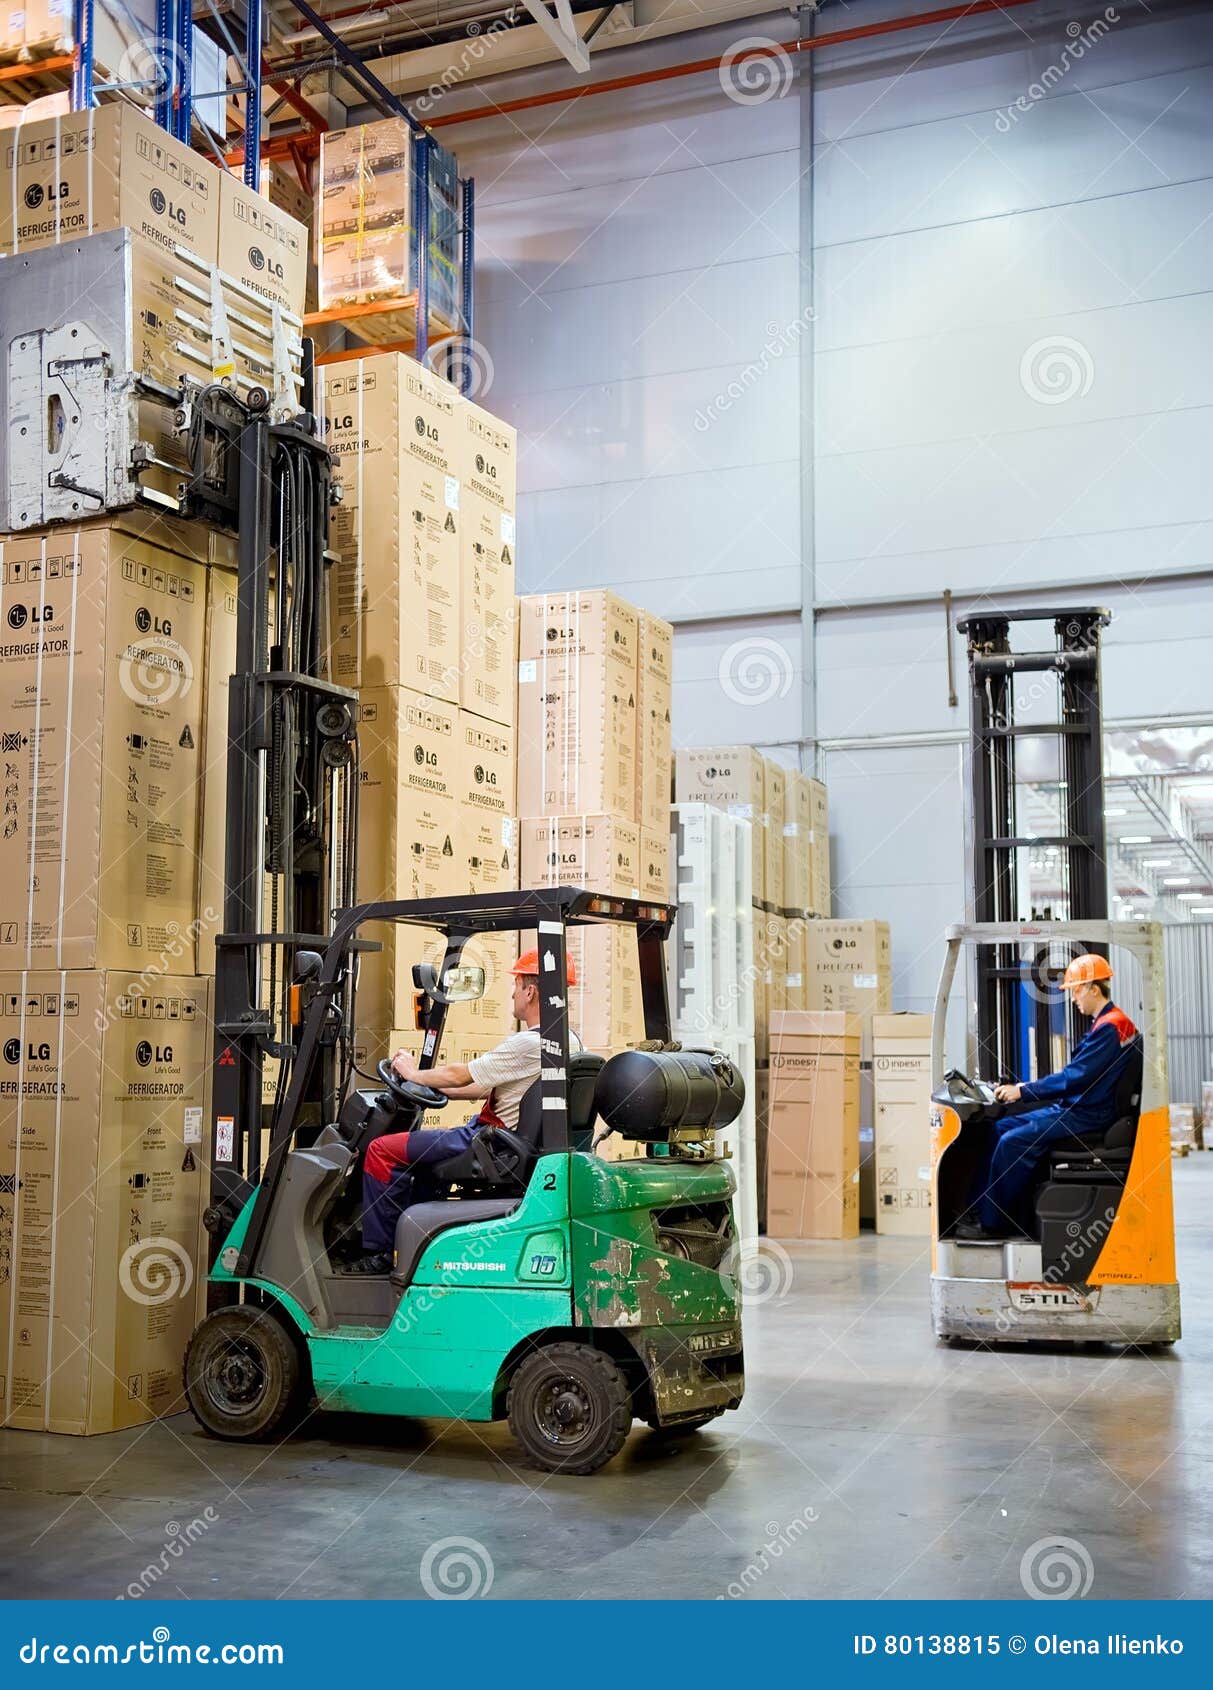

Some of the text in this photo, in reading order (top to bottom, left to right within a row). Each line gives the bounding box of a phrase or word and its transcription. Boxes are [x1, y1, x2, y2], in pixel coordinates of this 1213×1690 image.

[48, 182, 69, 201] LG
[169, 203, 186, 226] LG
[268, 259, 283, 279] LG
[334, 416, 353, 429] LG
[427, 425, 438, 441] LG
[486, 463, 496, 478] LG
[32, 605, 53, 622] LG
[154, 616, 171, 636] LG
[128, 645, 183, 672] REFRIGERATOR
[426, 752, 437, 766] LG
[409, 774, 446, 792] REFRIGERATOR
[486, 771, 496, 784] LG
[469, 792, 505, 809] REFRIGERATOR
[562, 854, 577, 863] LG
[28, 1043, 50, 1060] LG
[155, 1046, 173, 1062] LG
[128, 1083, 184, 1095] REFRIGERATOR
[22, 1127, 36, 1135] Side
[544, 1173, 557, 1191] 2
[443, 1262, 506, 1272] MITSUBISHI
[531, 1255, 557, 1275] 15
